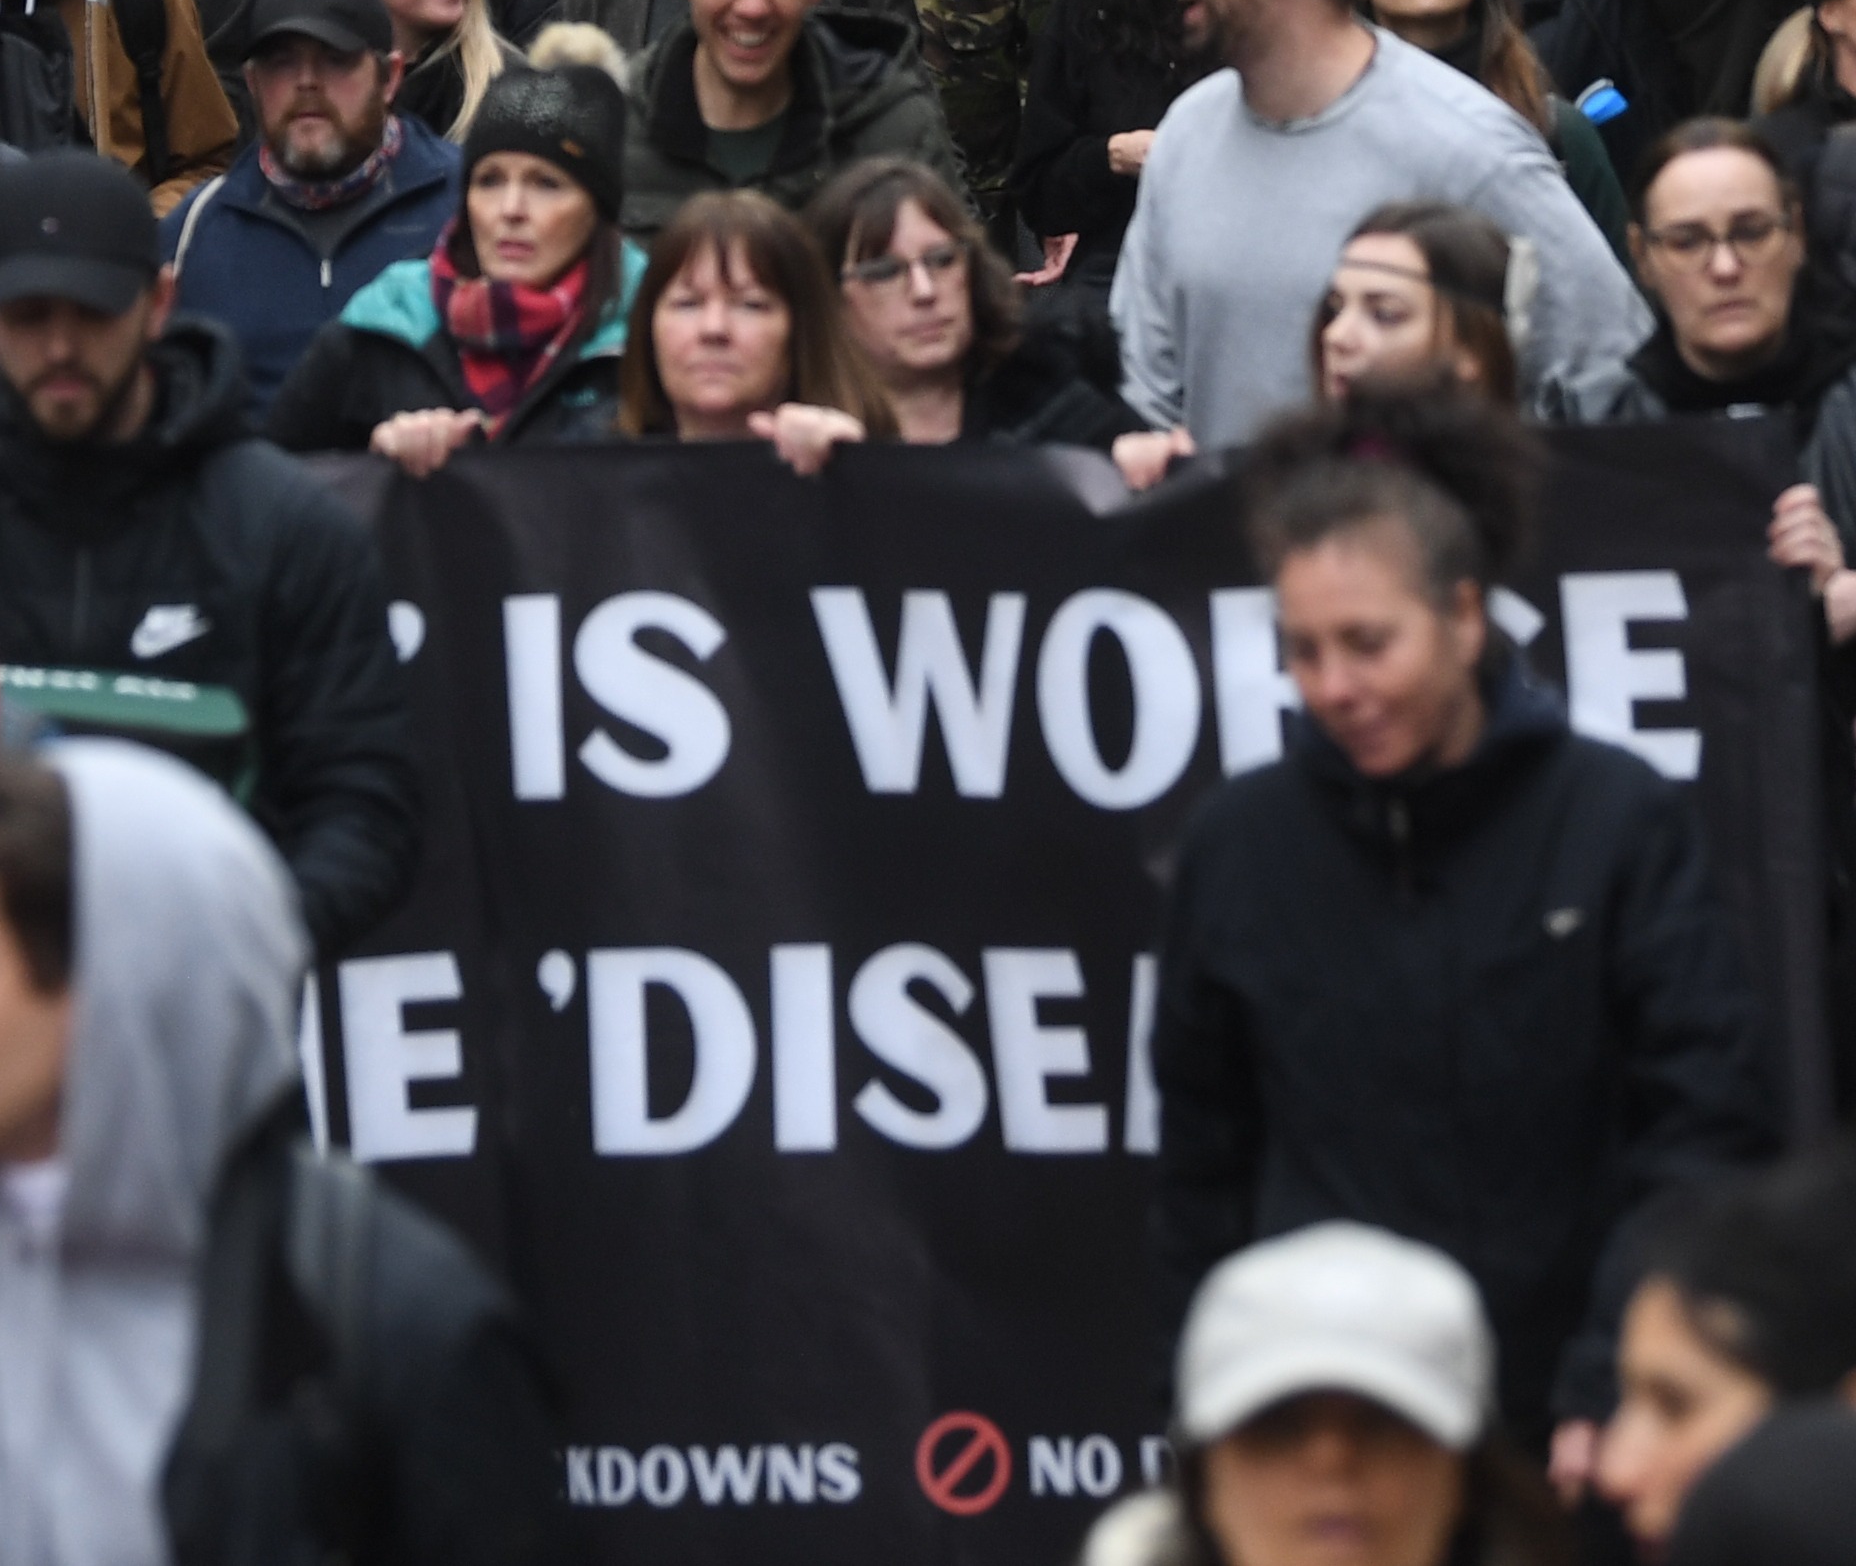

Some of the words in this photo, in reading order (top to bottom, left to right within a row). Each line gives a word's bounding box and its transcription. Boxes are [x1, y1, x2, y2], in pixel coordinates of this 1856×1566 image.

[502, 589, 733, 802] IS
[564, 1444, 862, 1507] KDOWNS
[1028, 1436, 1122, 1497] NO
